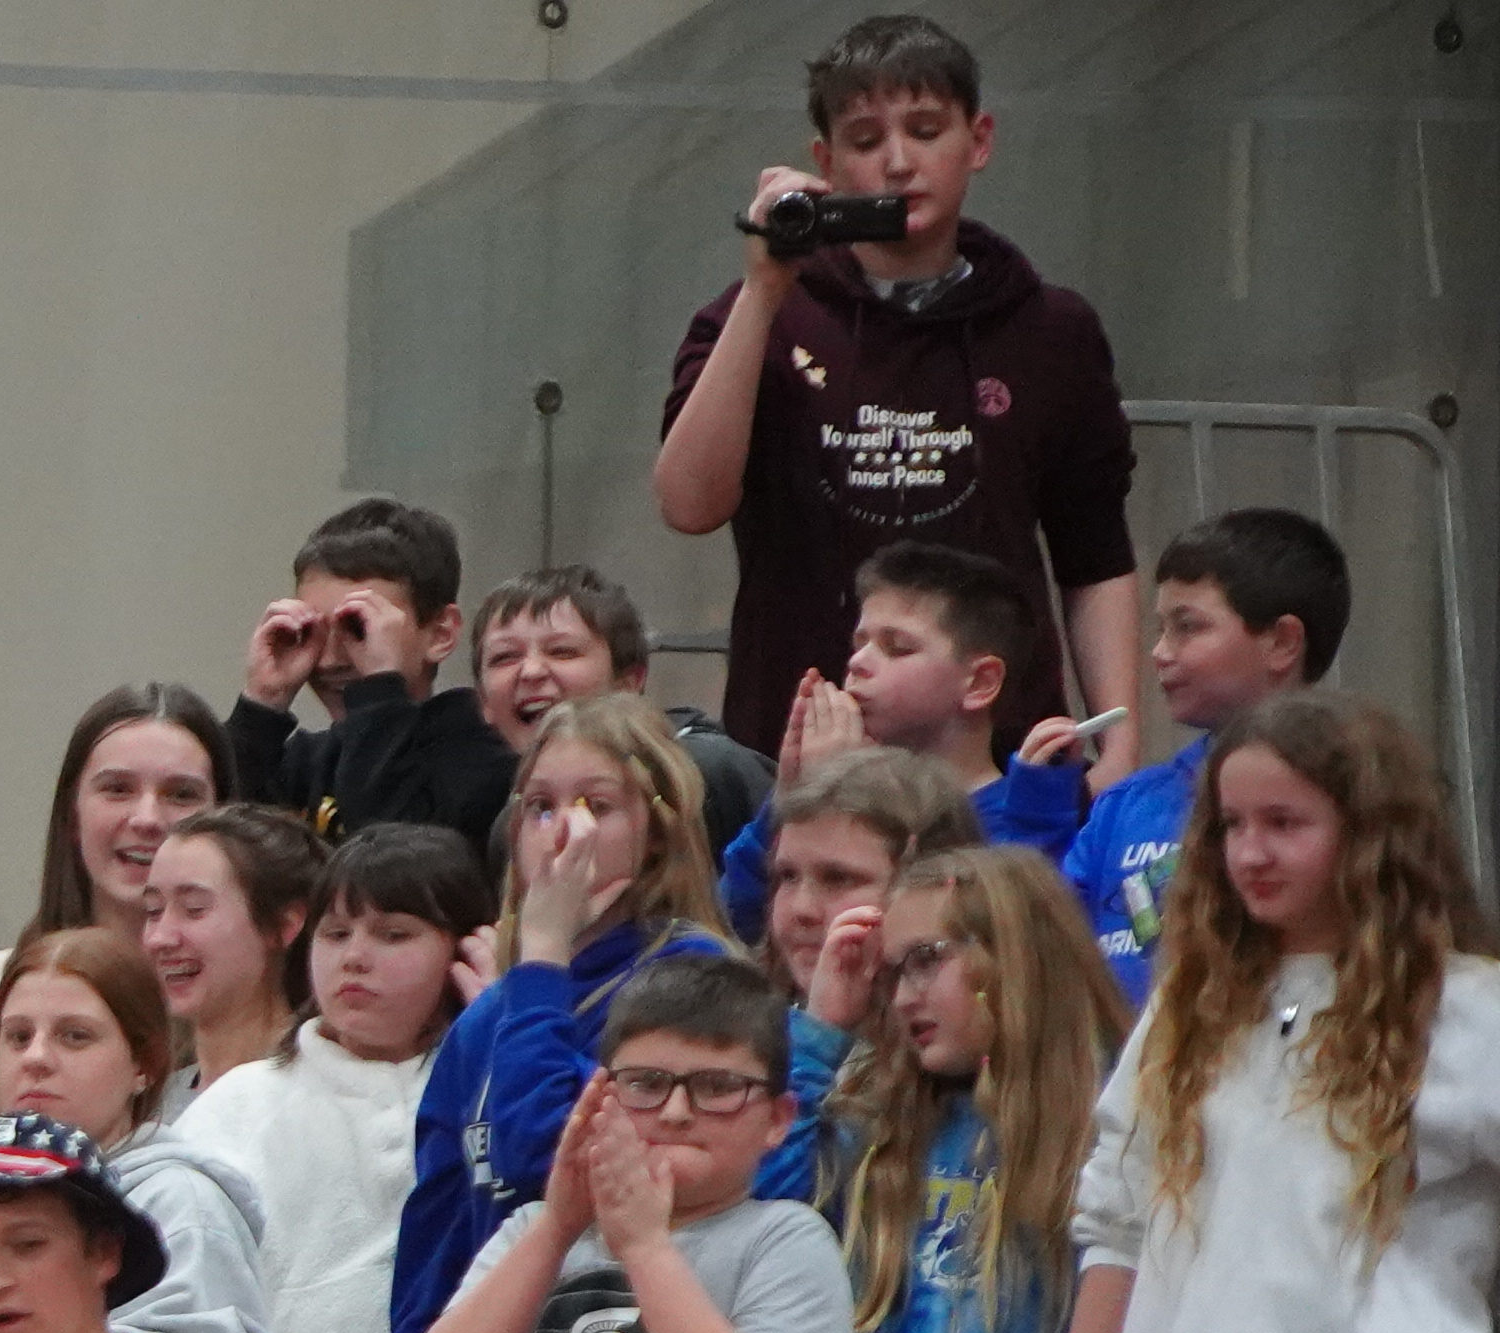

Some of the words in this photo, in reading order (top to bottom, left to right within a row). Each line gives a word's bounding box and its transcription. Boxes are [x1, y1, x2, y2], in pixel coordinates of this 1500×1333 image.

[857, 404, 937, 427] Discover
[821, 424, 895, 448] Yourself
[898, 424, 973, 453] Through
[848, 466, 891, 488] Inner
[893, 465, 946, 488] Peace
